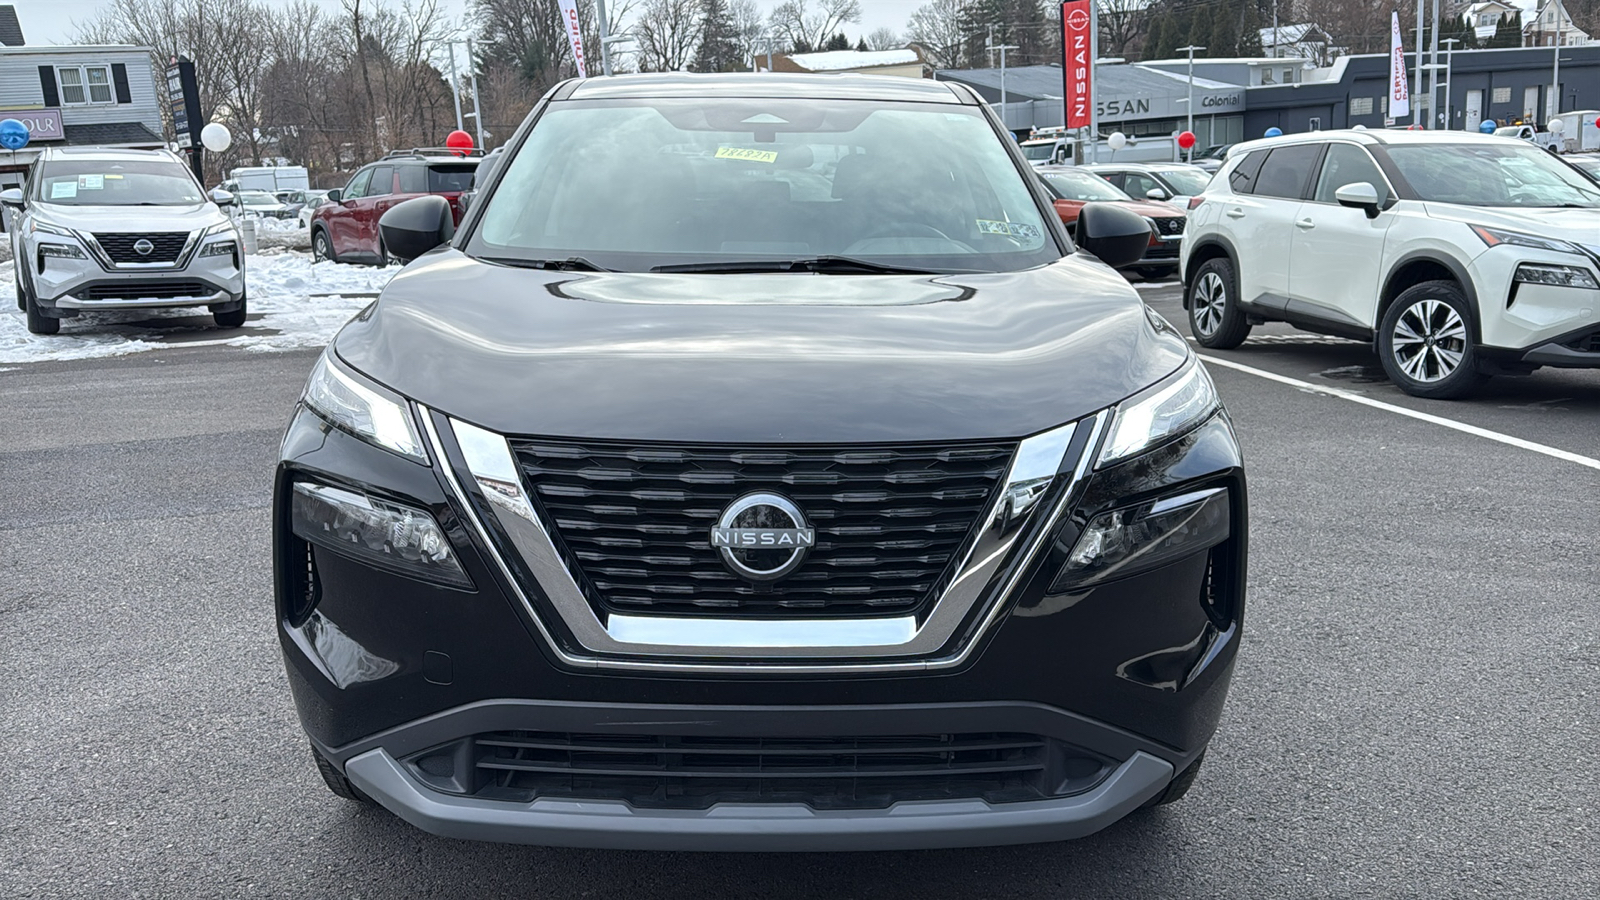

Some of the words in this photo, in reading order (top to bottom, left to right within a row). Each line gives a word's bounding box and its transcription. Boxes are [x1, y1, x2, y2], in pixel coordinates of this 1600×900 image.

[1074, 35, 1086, 117] NISSAN
[1097, 98, 1150, 116] SSAN
[1202, 94, 1240, 107] Colonial
[21, 118, 55, 132] OUR
[714, 531, 812, 545] NISSAN
